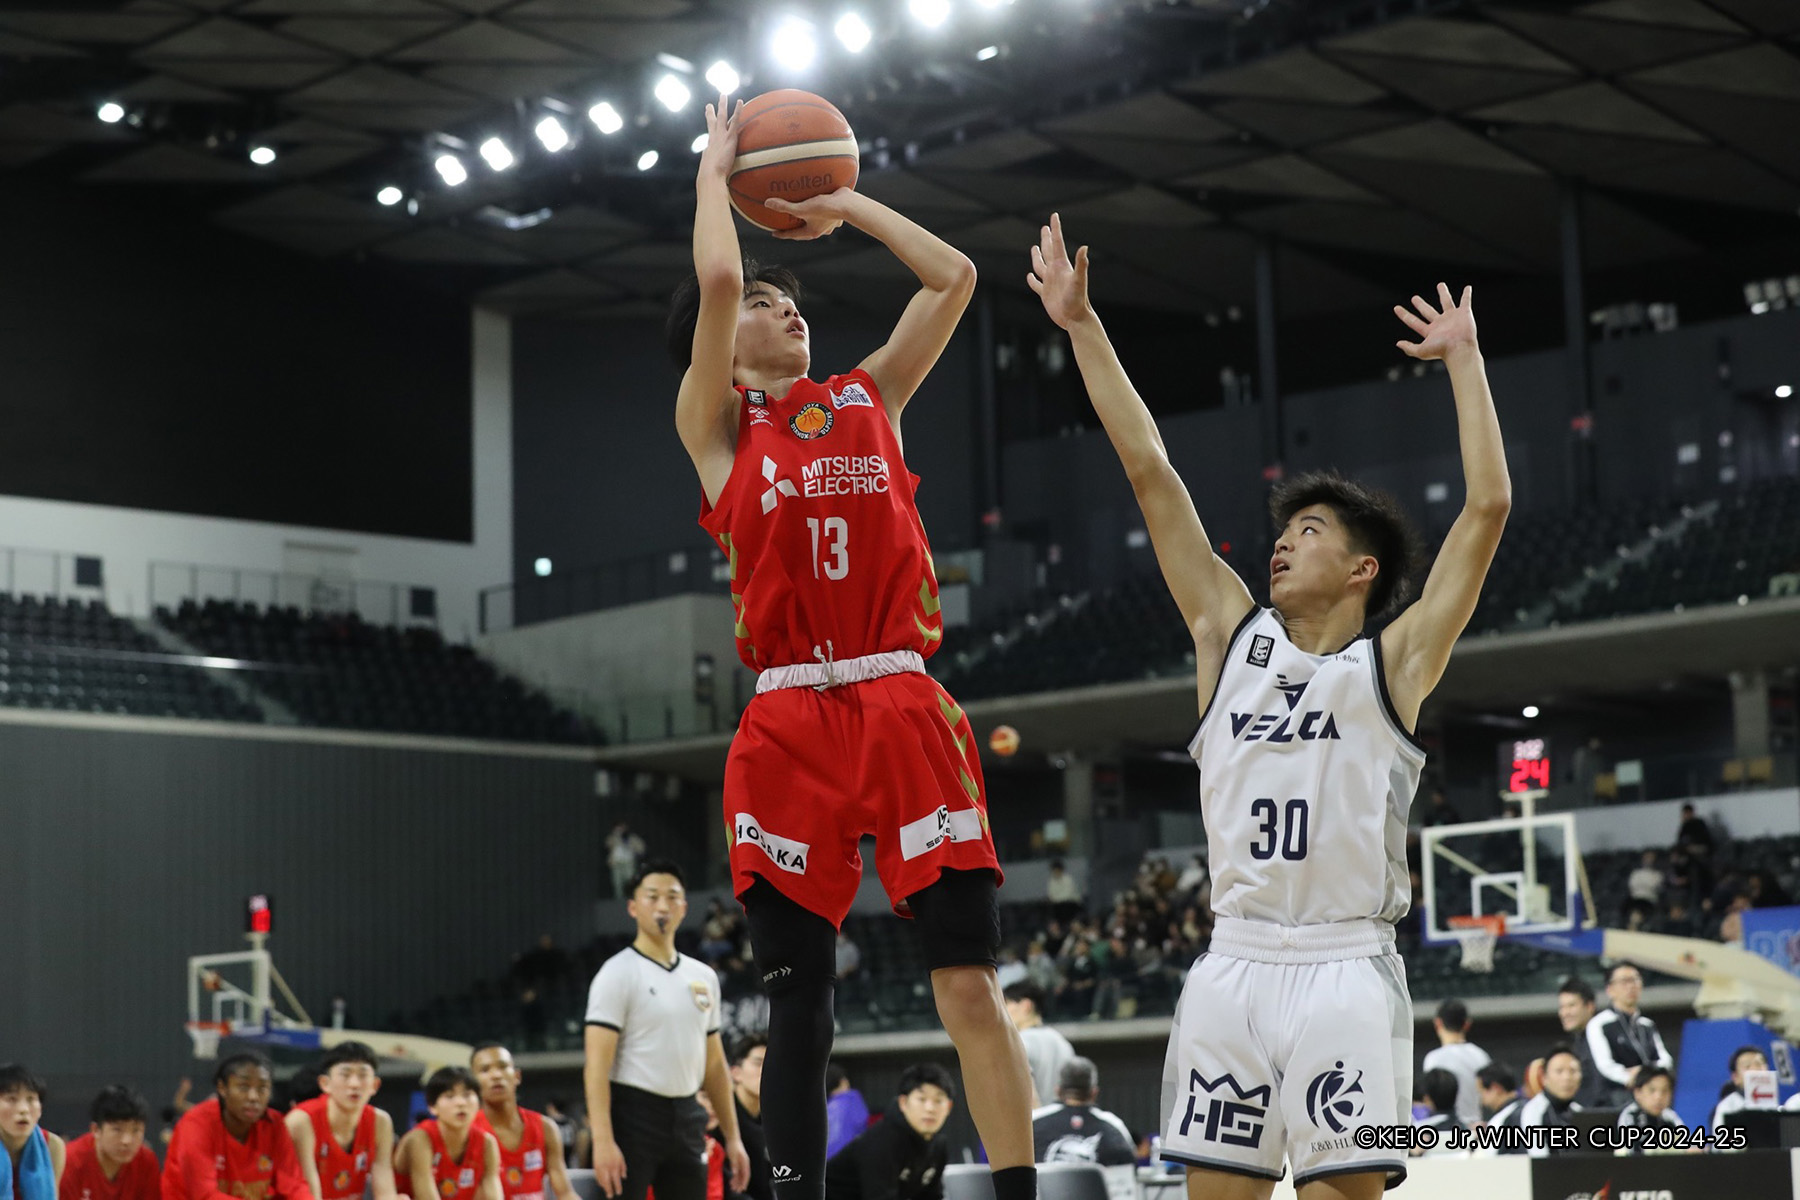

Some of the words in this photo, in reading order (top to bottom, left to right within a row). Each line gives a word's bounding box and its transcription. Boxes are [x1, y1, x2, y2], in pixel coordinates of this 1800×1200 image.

[770, 173, 832, 192] molten
[803, 474, 889, 498] ELECTRIC
[806, 516, 849, 581] 13
[1230, 711, 1341, 743] VELCA
[1510, 757, 1550, 793] 24
[1250, 798, 1308, 861] 30
[1311, 1139, 1333, 1153] K&B
